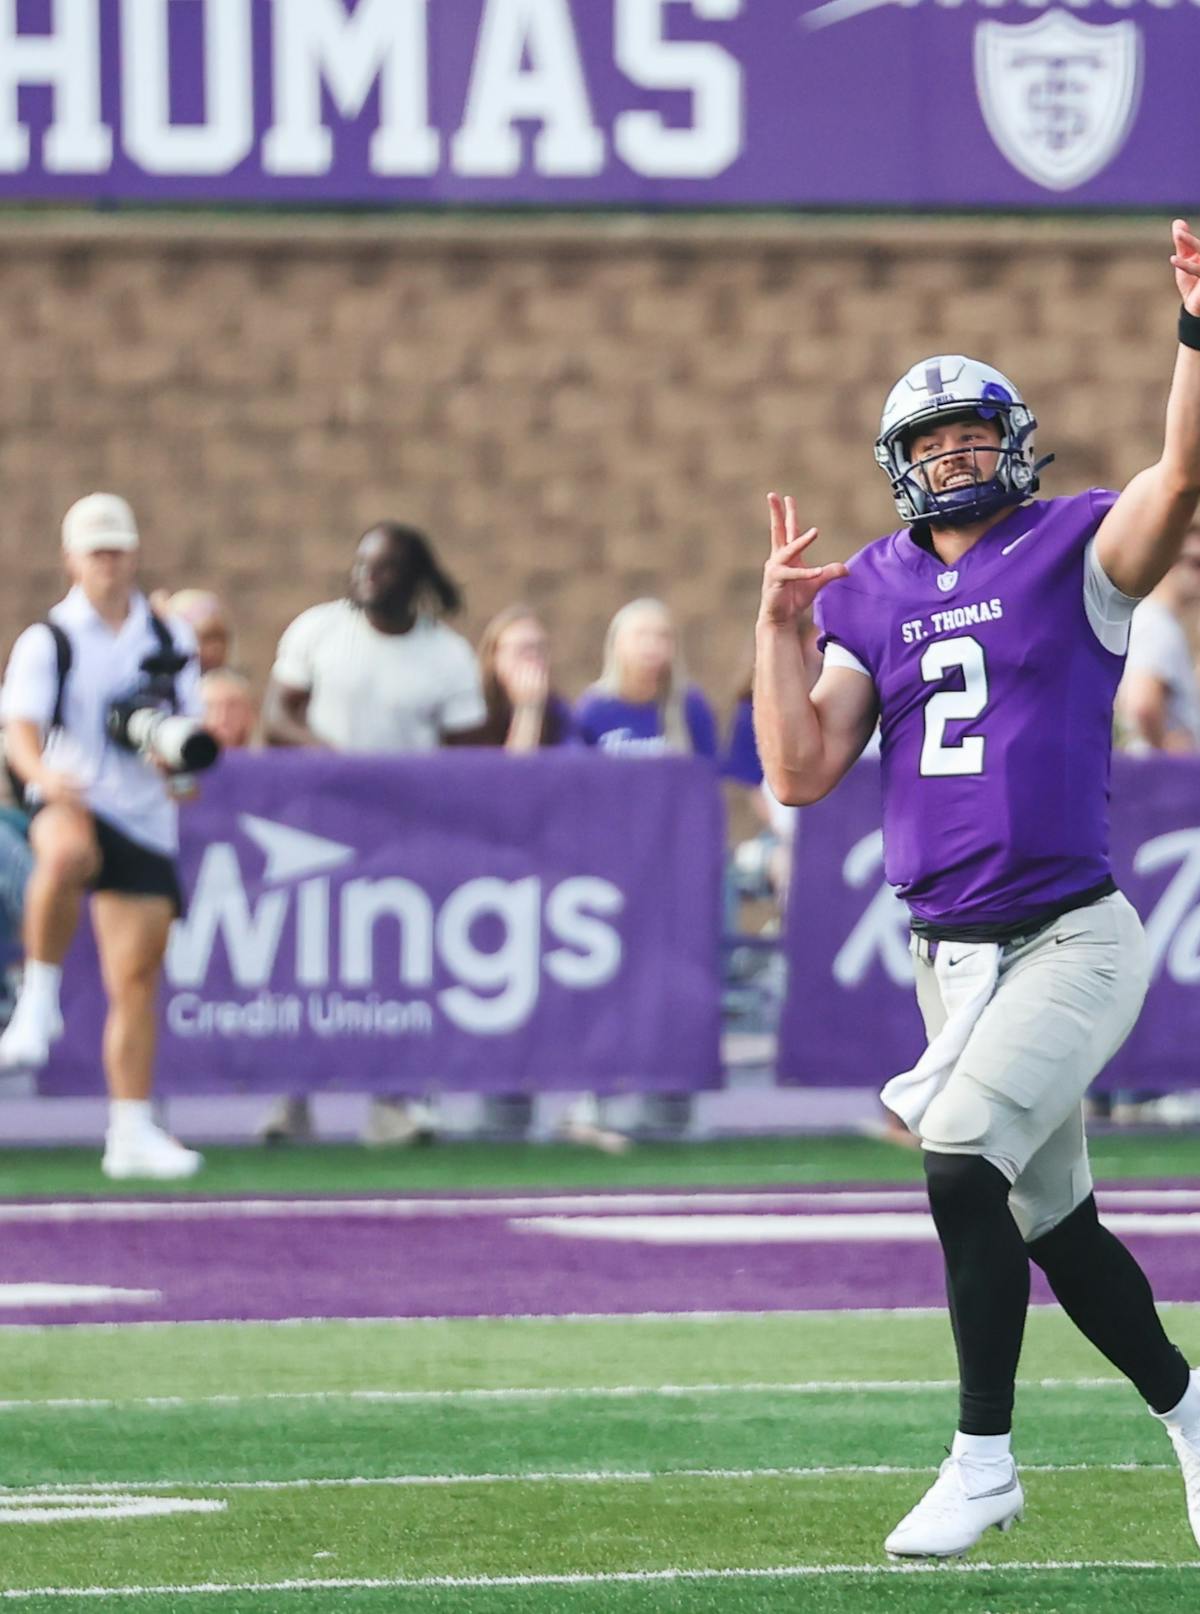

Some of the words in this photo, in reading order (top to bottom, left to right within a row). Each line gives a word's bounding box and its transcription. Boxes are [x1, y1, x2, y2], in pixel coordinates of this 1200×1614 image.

[902, 620, 928, 643] ST.
[931, 598, 1002, 632] THOMAS
[920, 635, 988, 776] 2
[165, 840, 624, 1034] Wings
[167, 991, 300, 1038] Credit
[307, 991, 433, 1038] Union
